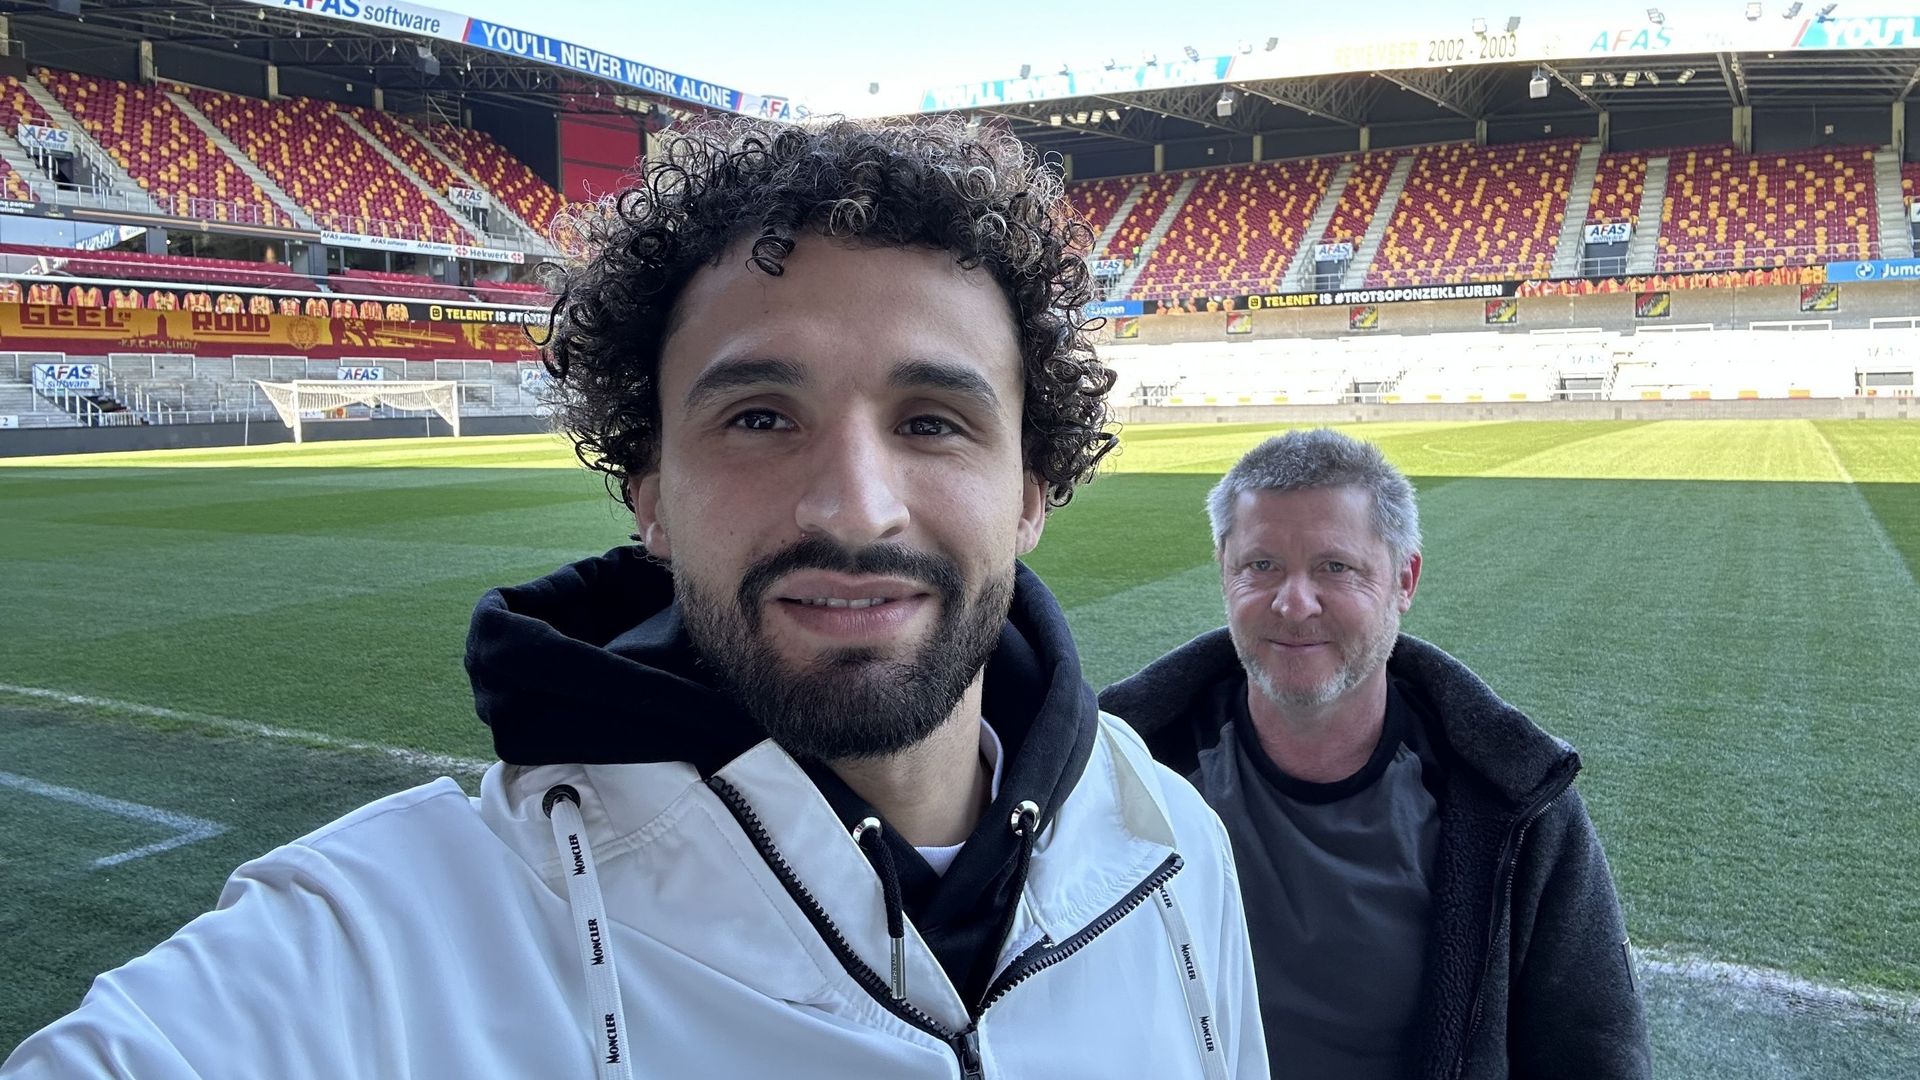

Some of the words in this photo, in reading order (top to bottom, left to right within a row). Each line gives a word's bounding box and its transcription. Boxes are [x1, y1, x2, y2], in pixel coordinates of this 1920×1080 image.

[363, 5, 441, 33] software
[1428, 38, 1465, 62] 2002
[1479, 33, 1517, 59] 2003
[1590, 26, 1674, 52] AFAS
[481, 22, 557, 62] YOU'LL
[560, 43, 622, 79] NEVER
[625, 62, 677, 94] WORK
[680, 80, 732, 109] ALONE
[759, 98, 809, 120] AFAS
[24, 126, 68, 142] AFAS
[456, 190, 483, 201] AFAS
[1590, 224, 1627, 236] AFAS
[470, 248, 509, 260] Hekwerk
[1095, 260, 1120, 269] AFAS
[1264, 294, 1318, 307] TELENET
[1319, 293, 1333, 305] IS
[1334, 284, 1503, 304] #TROTSOPONZEKLEUREN
[20, 304, 124, 328] GEEL
[191, 312, 271, 332] ROOD
[445, 308, 494, 321] TELENET
[495, 311, 507, 322] IS
[45, 366, 92, 379] AFAS
[343, 368, 379, 380] AFAS
[568, 833, 587, 876] MONCLER
[588, 918, 604, 967] MONCLER
[1181, 943, 1197, 981] MONCLER
[605, 1012, 621, 1065] MONCLER
[1200, 1015, 1215, 1053] MONCLER
